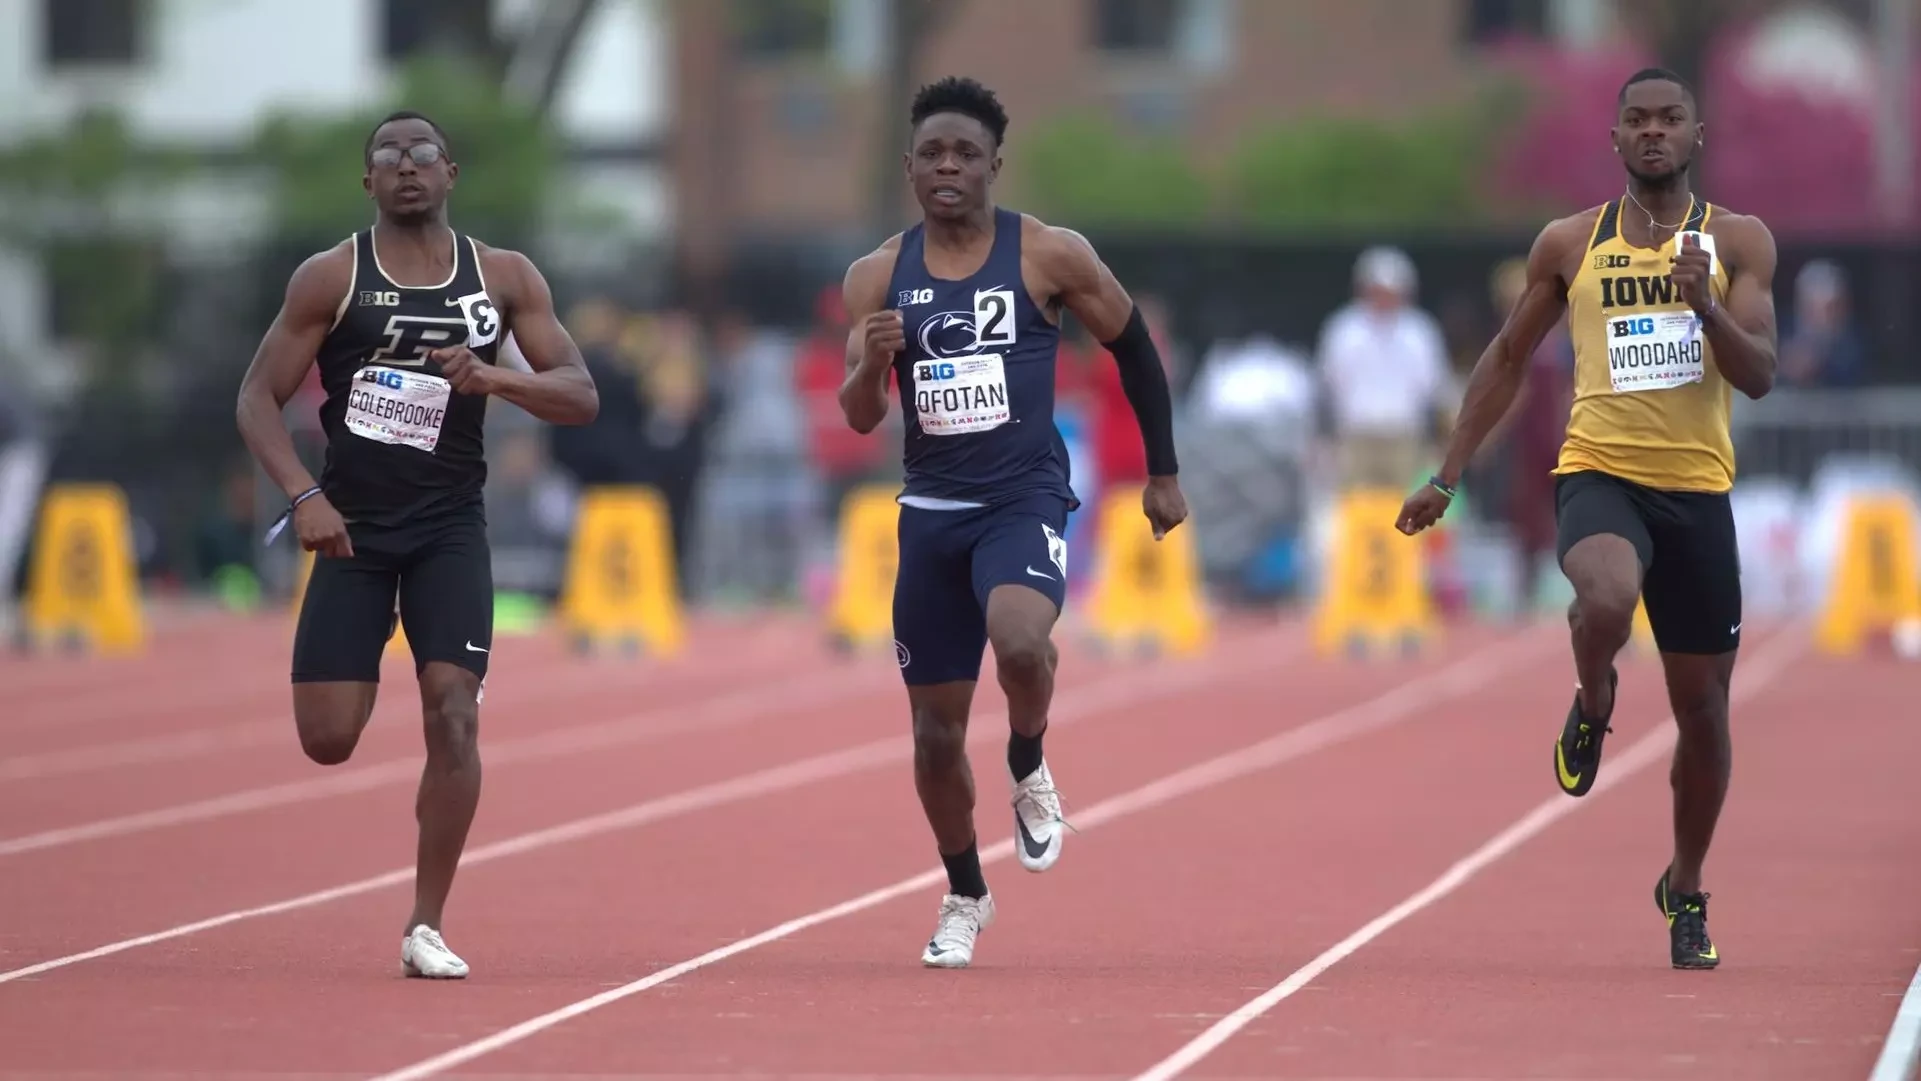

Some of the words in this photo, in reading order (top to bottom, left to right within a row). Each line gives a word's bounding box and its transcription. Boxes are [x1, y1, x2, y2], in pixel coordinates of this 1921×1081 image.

[1601, 274, 1684, 308] IOW
[978, 295, 1009, 342] 2
[368, 315, 470, 366] P
[1610, 340, 1702, 370] WOODARD
[349, 389, 444, 428] COLEBROOKE
[917, 382, 1006, 414] OFOTAN
